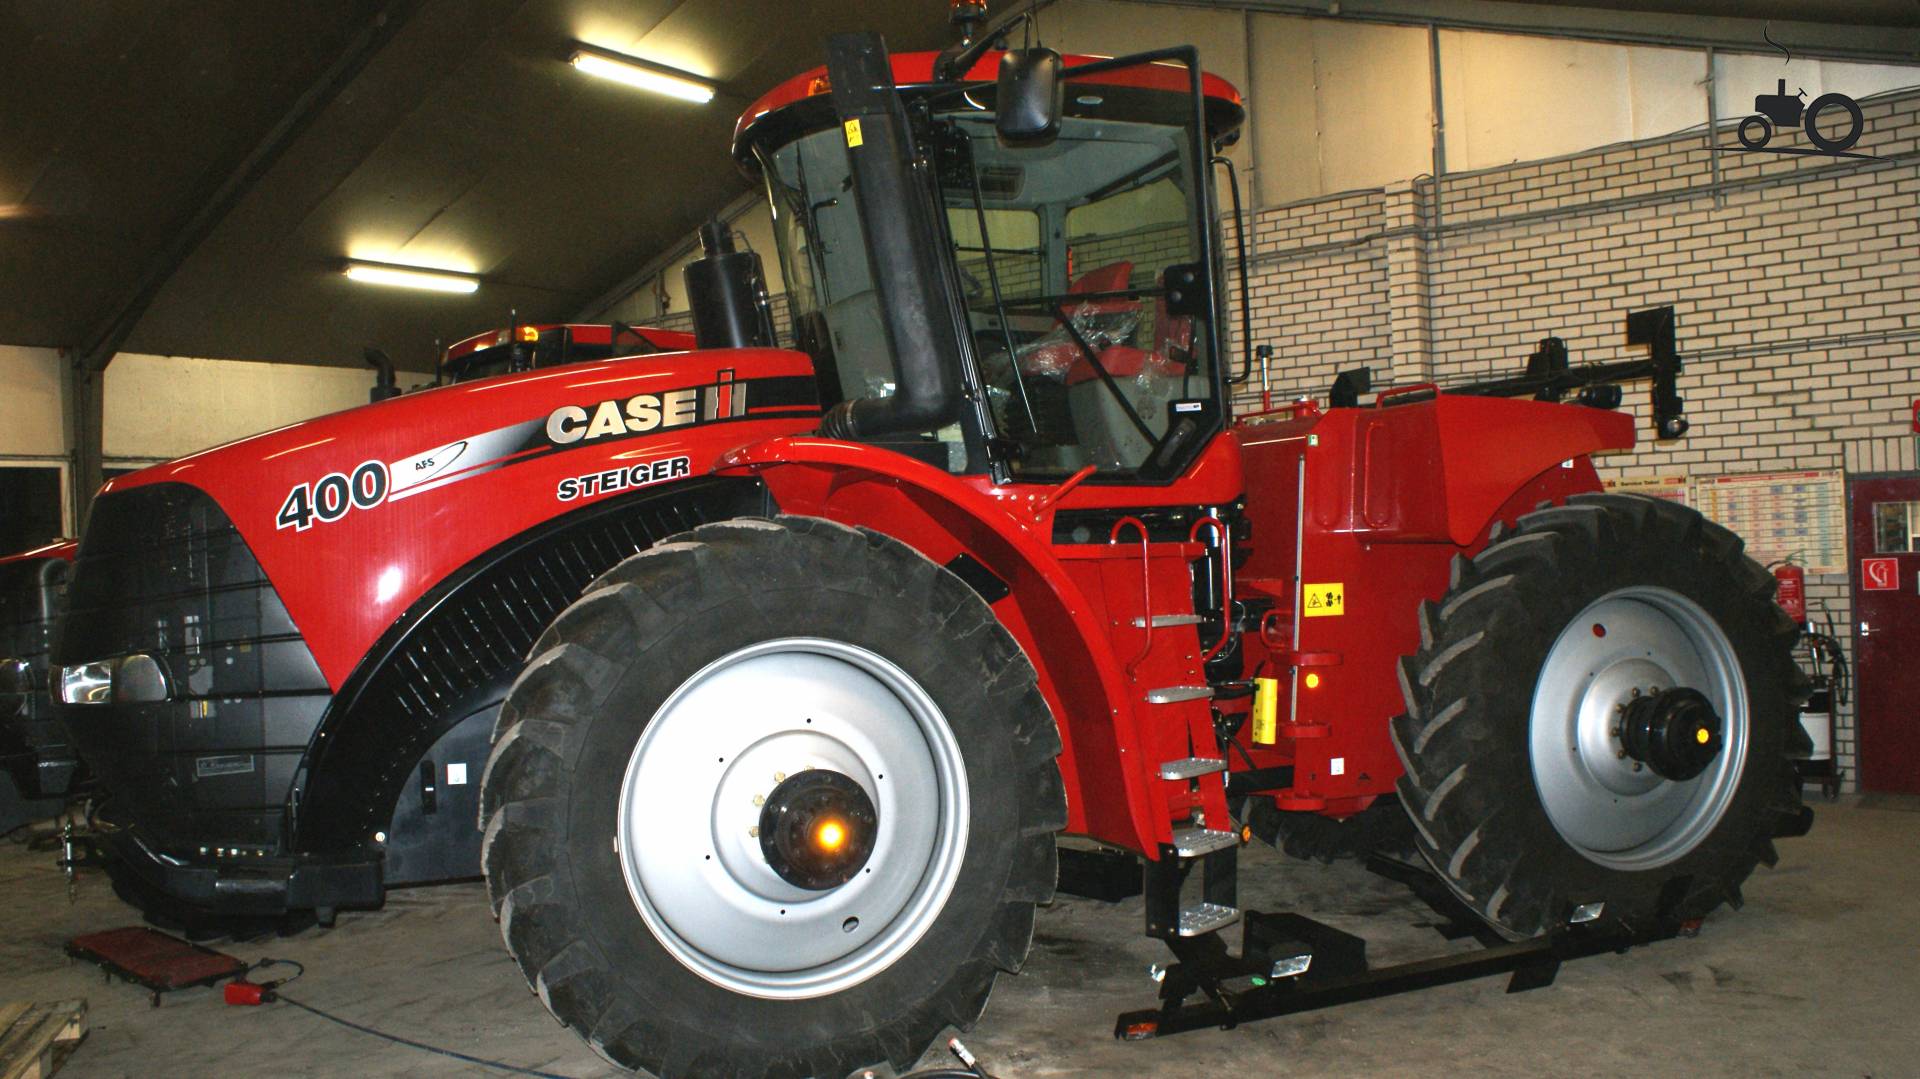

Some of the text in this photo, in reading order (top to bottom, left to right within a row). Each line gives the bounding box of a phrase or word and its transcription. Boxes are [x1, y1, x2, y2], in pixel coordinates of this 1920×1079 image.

[546, 389, 696, 444] CASE
[415, 457, 435, 471] AFS
[556, 455, 690, 502] STEIGER
[276, 460, 389, 532] 400
